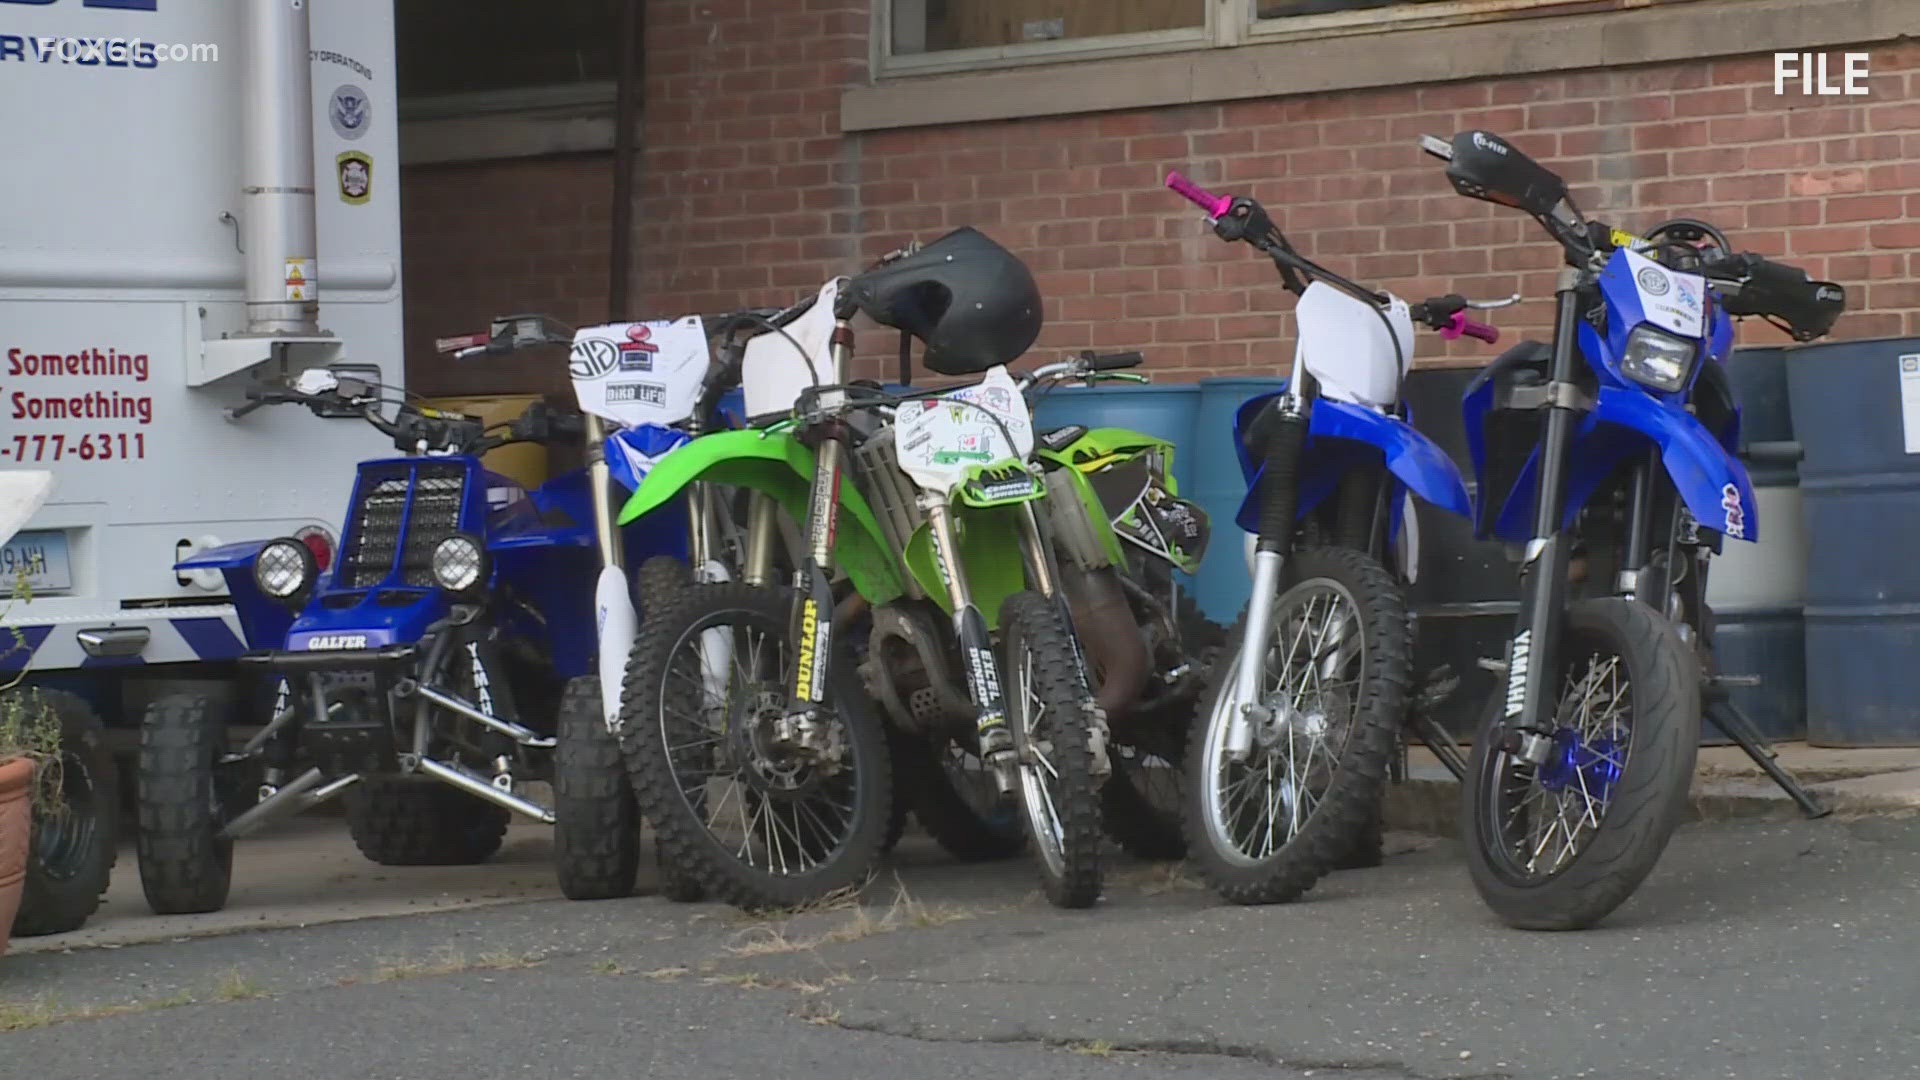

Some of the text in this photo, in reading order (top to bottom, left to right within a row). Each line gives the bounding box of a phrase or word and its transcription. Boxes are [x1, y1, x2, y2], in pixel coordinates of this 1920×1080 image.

[320, 50, 372, 80] OPERATIONS
[8, 348, 148, 381] Something
[11, 391, 152, 424] Something
[308, 635, 367, 650] GALFER
[796, 598, 817, 702] DUNLOP
[465, 641, 494, 731] YAMAH
[969, 646, 989, 707] DUNLOP
[980, 648, 1001, 701] EXCEL
[1505, 629, 1531, 717] YAMAHA
